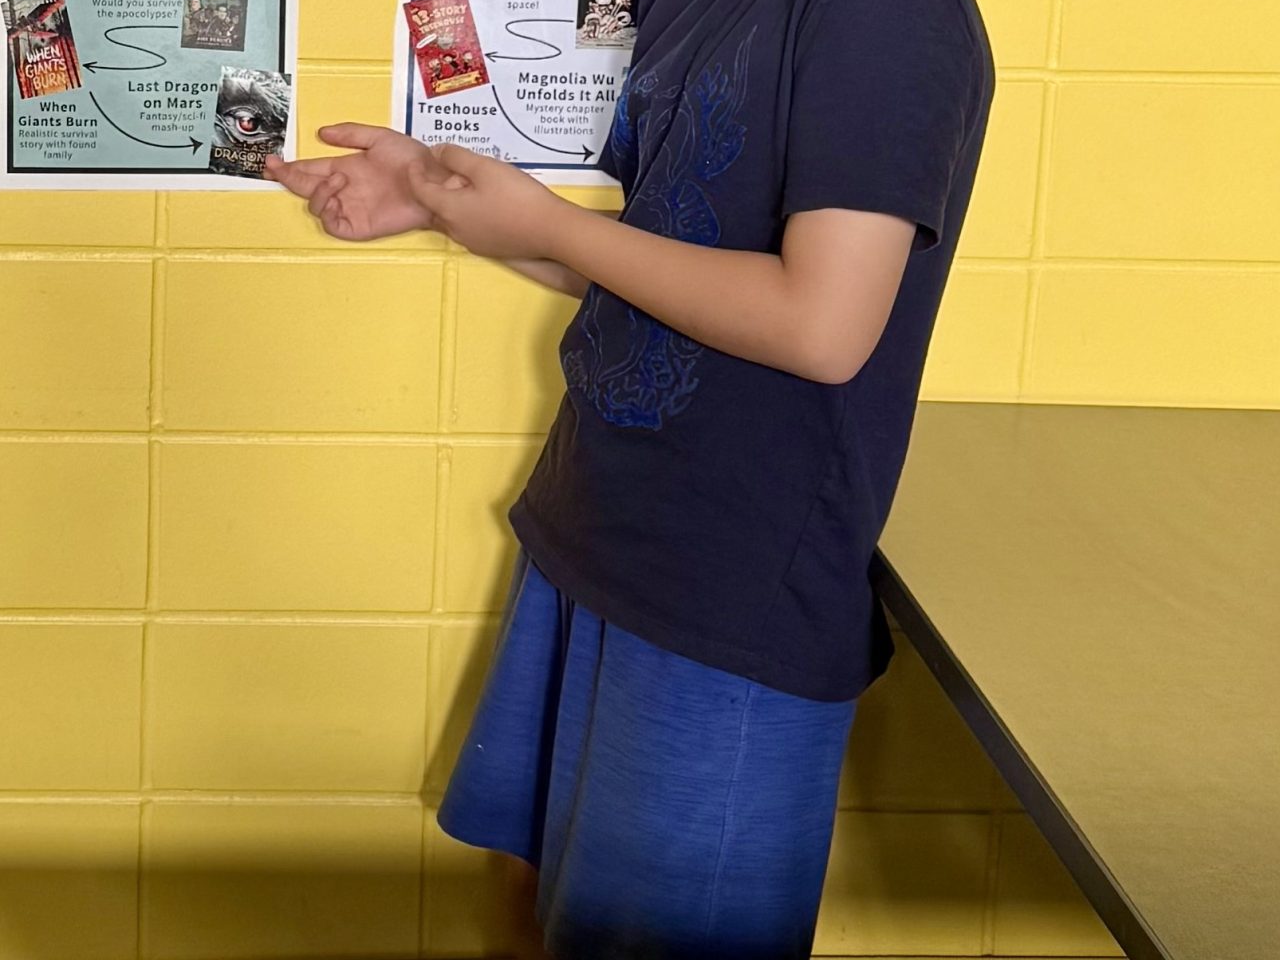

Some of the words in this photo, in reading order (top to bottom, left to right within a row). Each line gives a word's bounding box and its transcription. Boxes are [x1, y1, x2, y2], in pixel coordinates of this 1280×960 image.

[27, 48, 60, 65] WHEN
[25, 59, 66, 80] GIANTS
[33, 75, 66, 90] BURN
[519, 72, 587, 85] Magnolia
[592, 74, 614, 84] Wu
[128, 81, 160, 91] Last
[165, 81, 217, 95] Dragon
[517, 89, 575, 101] Unfolds
[581, 91, 591, 101] It
[40, 102, 76, 112] When
[144, 100, 161, 108] on
[168, 98, 202, 108] Mars
[419, 103, 497, 115] Treehouse
[19, 116, 62, 127] Giants
[67, 117, 97, 127] Burn
[434, 120, 479, 132] Books
